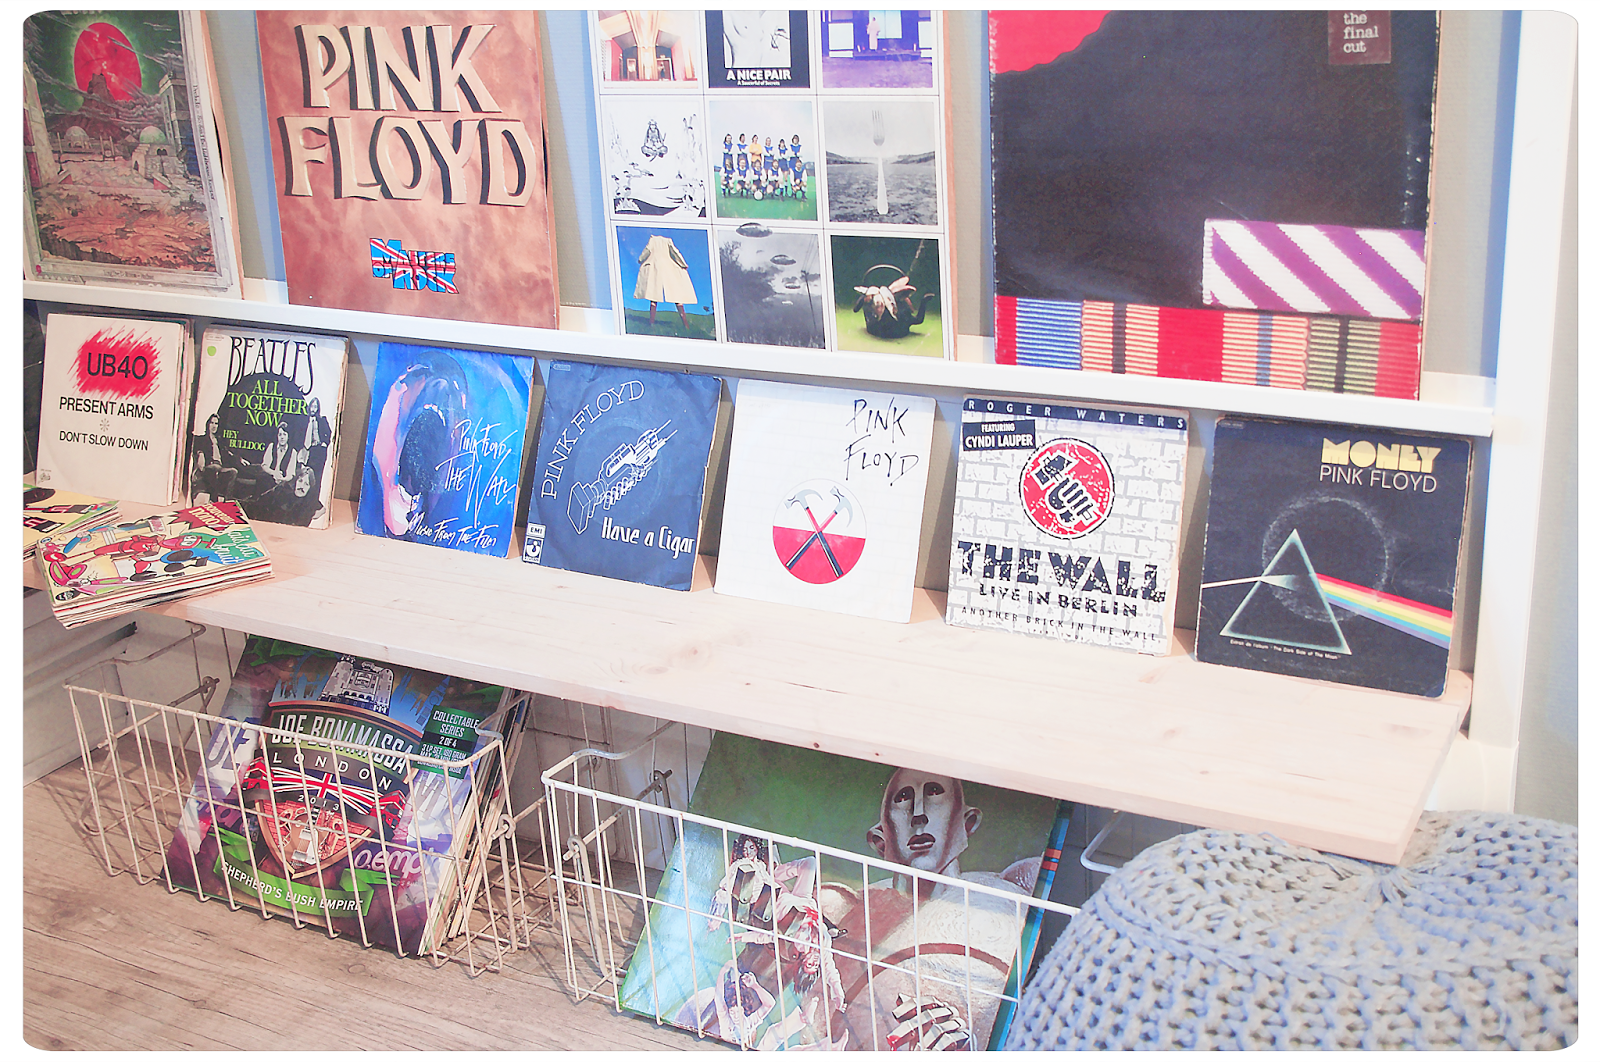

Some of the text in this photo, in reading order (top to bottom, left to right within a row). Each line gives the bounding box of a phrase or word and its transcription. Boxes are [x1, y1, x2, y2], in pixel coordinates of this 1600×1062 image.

[1343, 12, 1367, 25] the
[1343, 25, 1379, 39] final
[1343, 40, 1367, 53] cut
[294, 24, 502, 113] PINK
[726, 69, 792, 80] A NICE PAIR
[279, 115, 536, 207] FLOYD
[87, 352, 148, 380] UB40
[228, 336, 316, 396] BEATLES
[252, 379, 283, 397] ALL
[59, 396, 154, 420] PRESENT ARMS
[227, 391, 308, 416] TOGETHER
[968, 400, 1184, 429] ROGER WATERS
[244, 409, 284, 428] NOW
[845, 396, 910, 443] PINK
[981, 422, 1016, 433] FEATURING
[59, 430, 149, 451] DON'T SLOW DOWN
[222, 429, 240, 440] HEY
[229, 439, 266, 452] BULLDOG
[541, 380, 646, 500] PINK FLOYD
[965, 433, 1034, 449] CYNDI LAUPER
[843, 433, 920, 487] FLOYD
[1321, 437, 1442, 474] MONEY
[1319, 464, 1438, 493] PINK FLOYD
[530, 527, 543, 535] EMI
[601, 516, 695, 560] Have a Cigar
[957, 540, 1166, 604] THE WALL
[979, 583, 1137, 617] LIVE IN BERLIN
[961, 606, 1018, 622] ANOTHER
[1026, 615, 1064, 628] BRICK
[1071, 622, 1084, 631] IN
[1091, 624, 1115, 636] THE
[1122, 628, 1156, 642] WALL
[432, 710, 480, 729] COLLECTABLE
[439, 723, 465, 738] SERIES
[271, 714, 308, 744] JOE
[308, 715, 414, 775] BONAMASSA
[421, 744, 426, 752] 3
[439, 737, 458, 747] 2 OF 4
[272, 752, 392, 791] LONDON
[297, 794, 340, 812] 2013
[285, 893, 316, 908] BUSH
[319, 898, 363, 911] EMPIRE
